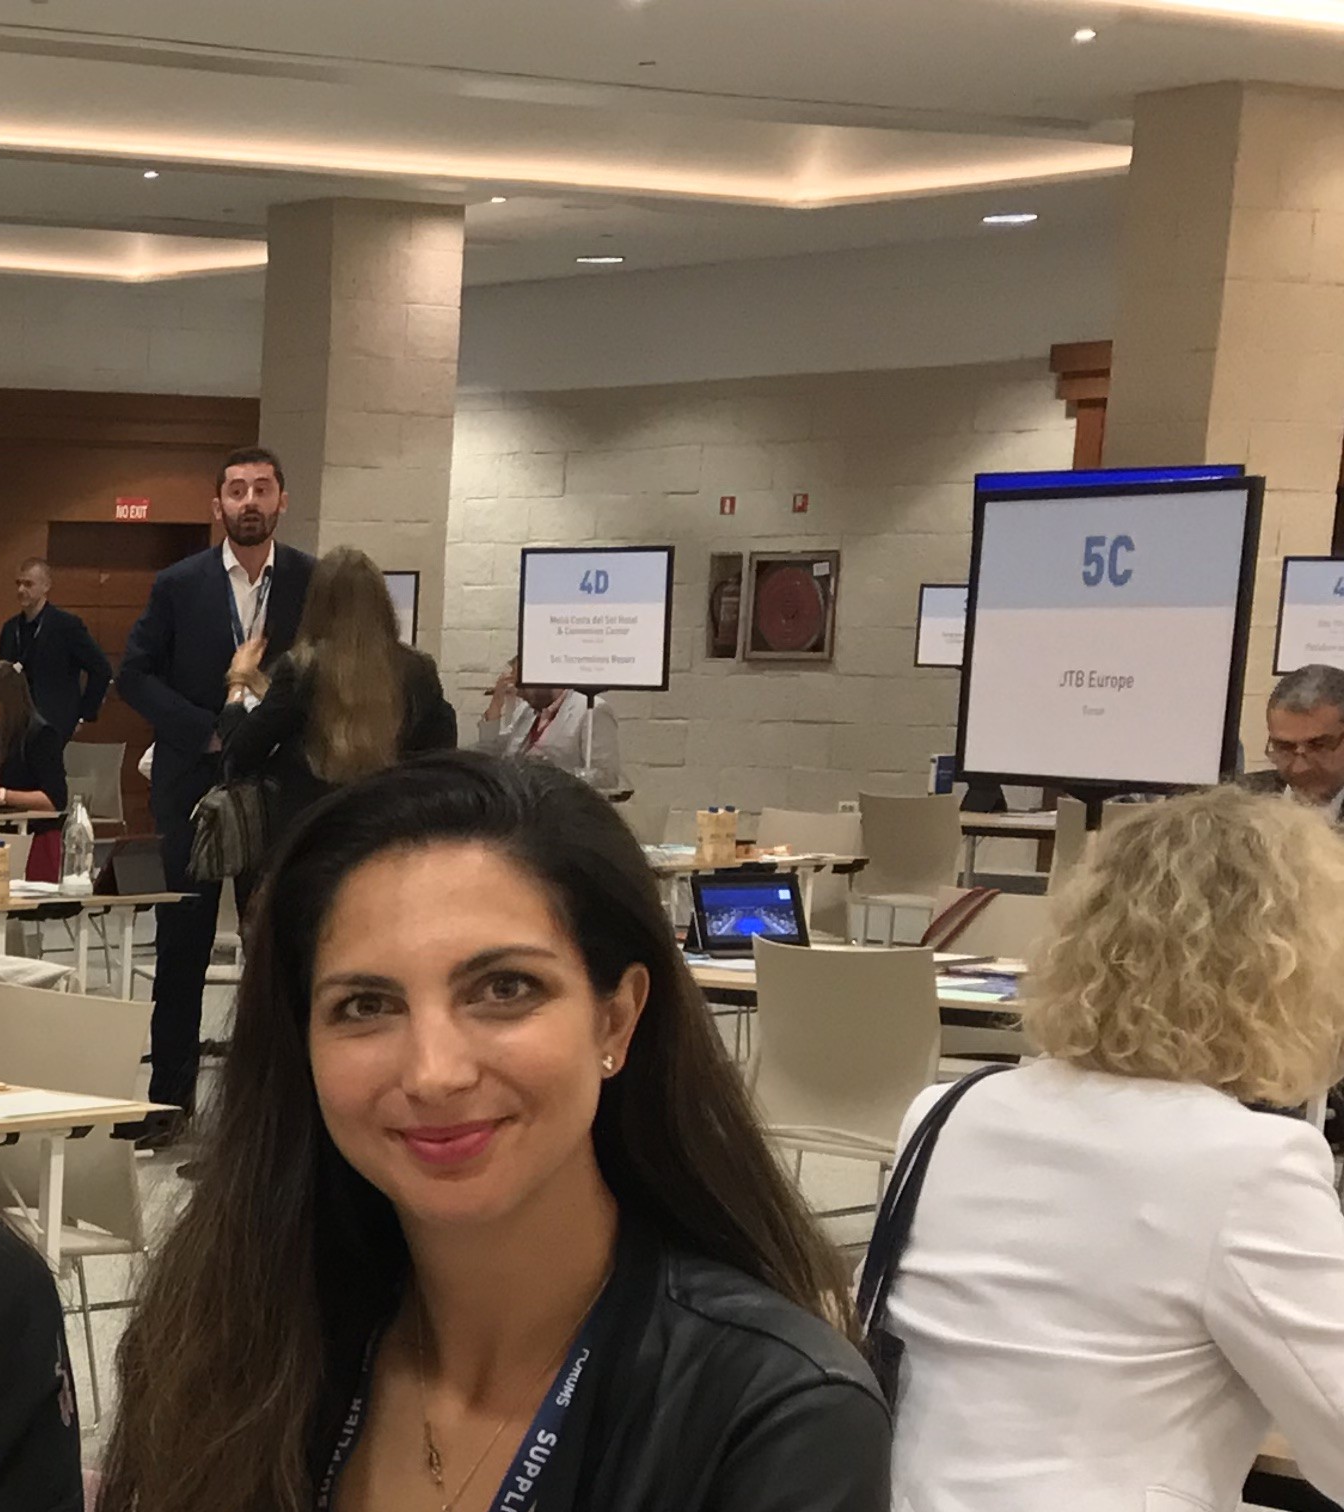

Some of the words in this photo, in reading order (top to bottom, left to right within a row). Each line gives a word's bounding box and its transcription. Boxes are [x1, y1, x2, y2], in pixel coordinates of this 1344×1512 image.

[116, 504, 129, 519] NO
[130, 504, 148, 519] EXIT
[1081, 534, 1137, 588] 5C
[578, 570, 609, 595] 4D
[1058, 669, 1086, 691] JTB
[1088, 669, 1135, 693] Europe
